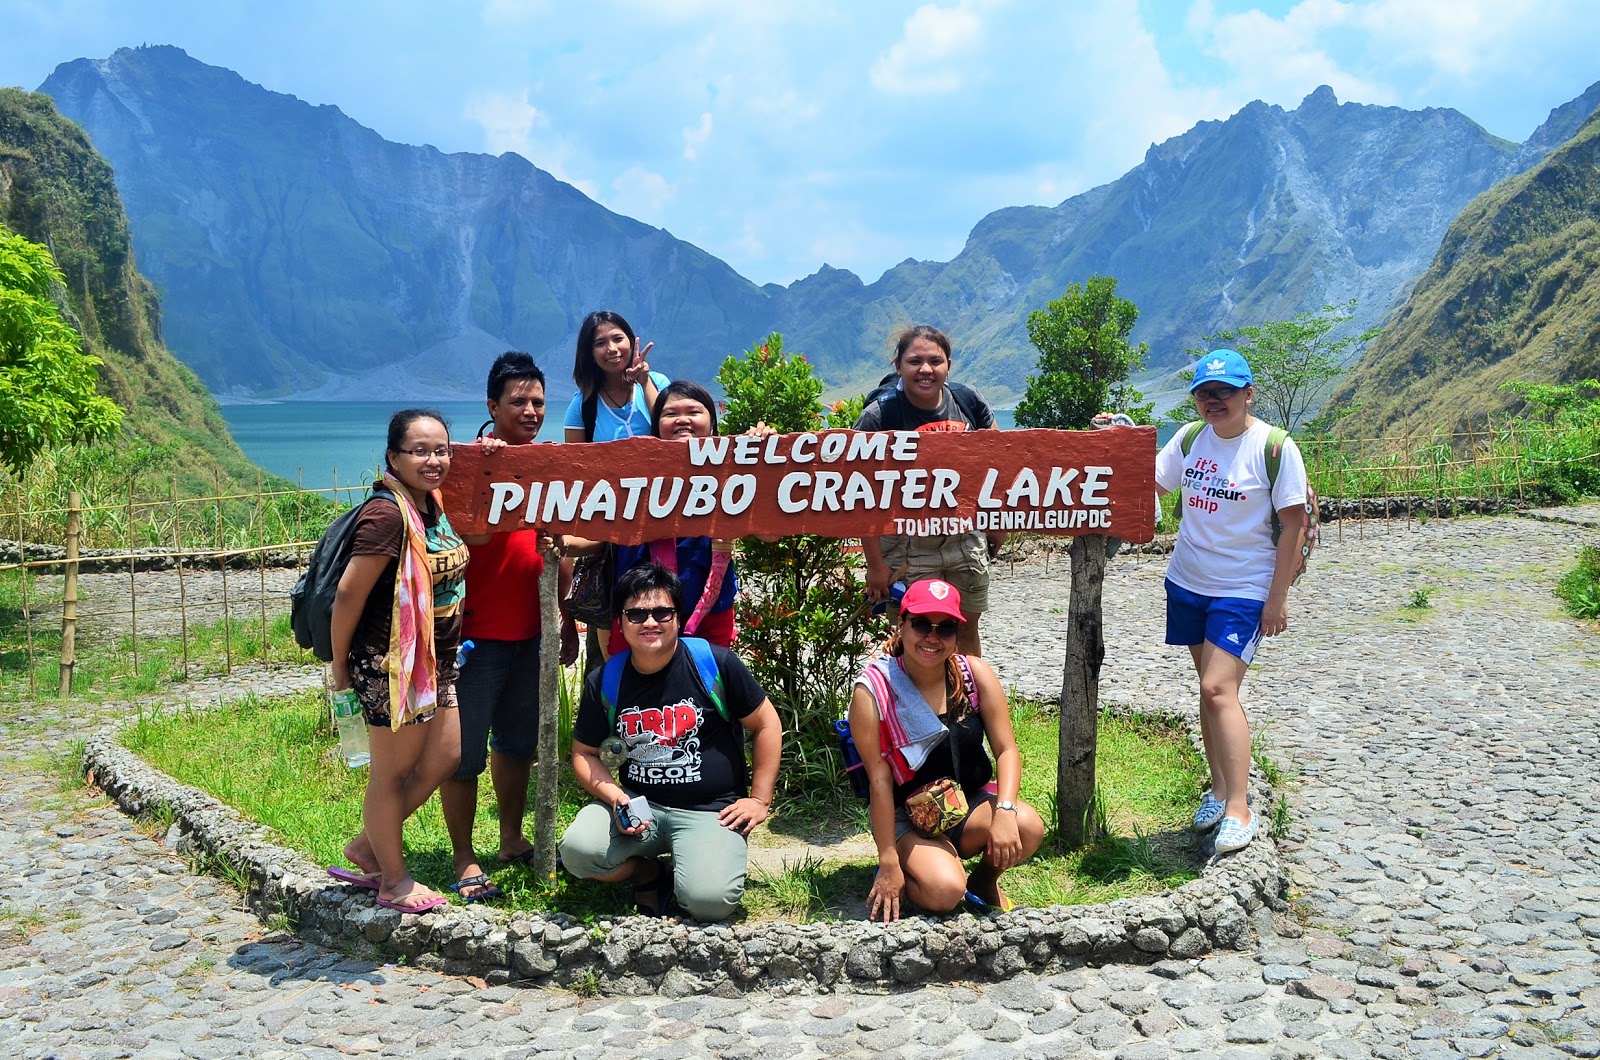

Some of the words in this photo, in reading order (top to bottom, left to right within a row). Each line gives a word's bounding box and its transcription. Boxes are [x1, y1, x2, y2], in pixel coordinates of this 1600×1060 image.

[689, 431, 920, 465] WELCOME
[1194, 457, 1218, 473] it's
[488, 474, 757, 525] PINATUBO
[777, 469, 960, 513] CRATER
[977, 466, 1114, 508] LAKE
[1189, 495, 1218, 514] ship
[893, 517, 973, 537] TOURISM
[976, 509, 1113, 531] DENR/LGU/PDC
[620, 703, 698, 737] TRIP
[627, 774, 702, 785] PHILIPPINES
